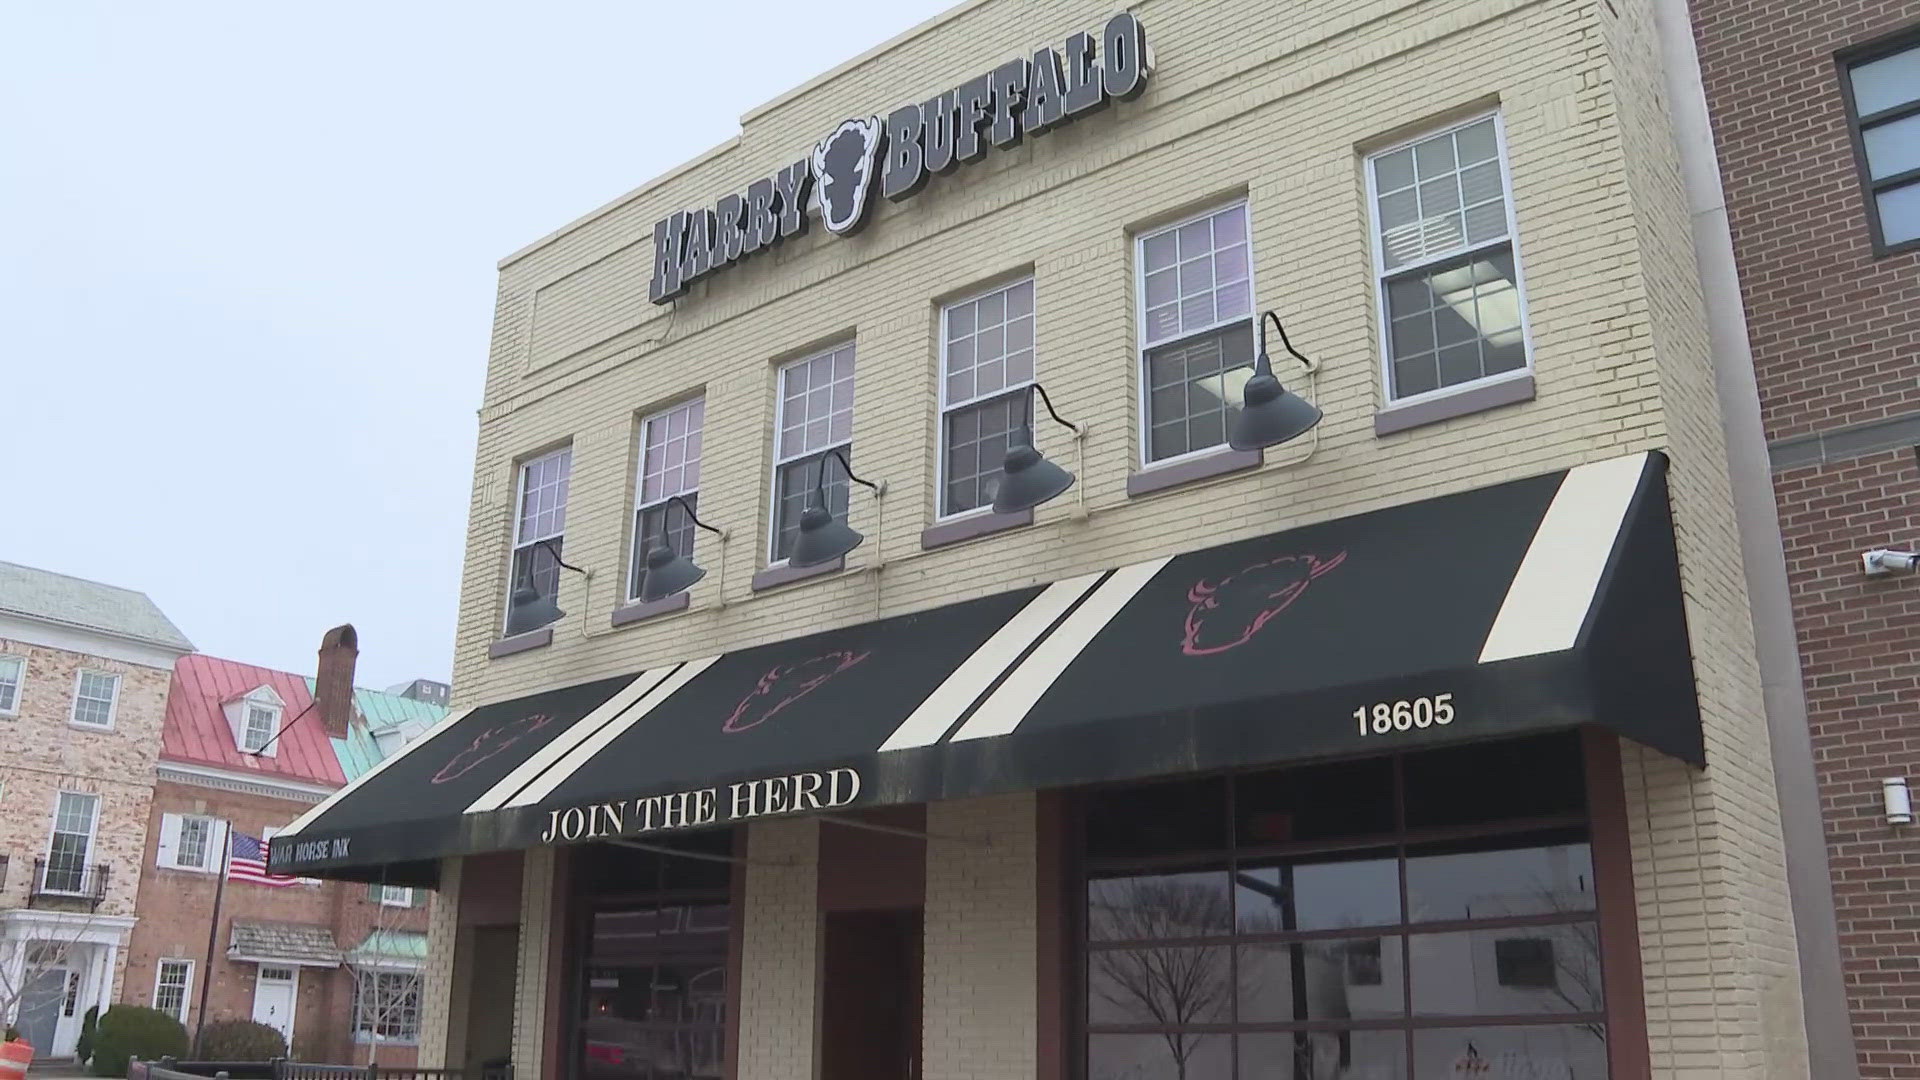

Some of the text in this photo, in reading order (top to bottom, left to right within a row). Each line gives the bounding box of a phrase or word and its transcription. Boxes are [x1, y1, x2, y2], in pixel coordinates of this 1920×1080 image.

[649, 13, 1149, 304] HARRY BUFFALO
[1352, 692, 1454, 737] 18605
[541, 768, 861, 844] JOIN THE HERD
[269, 837, 351, 865] WAR HORSE INK
